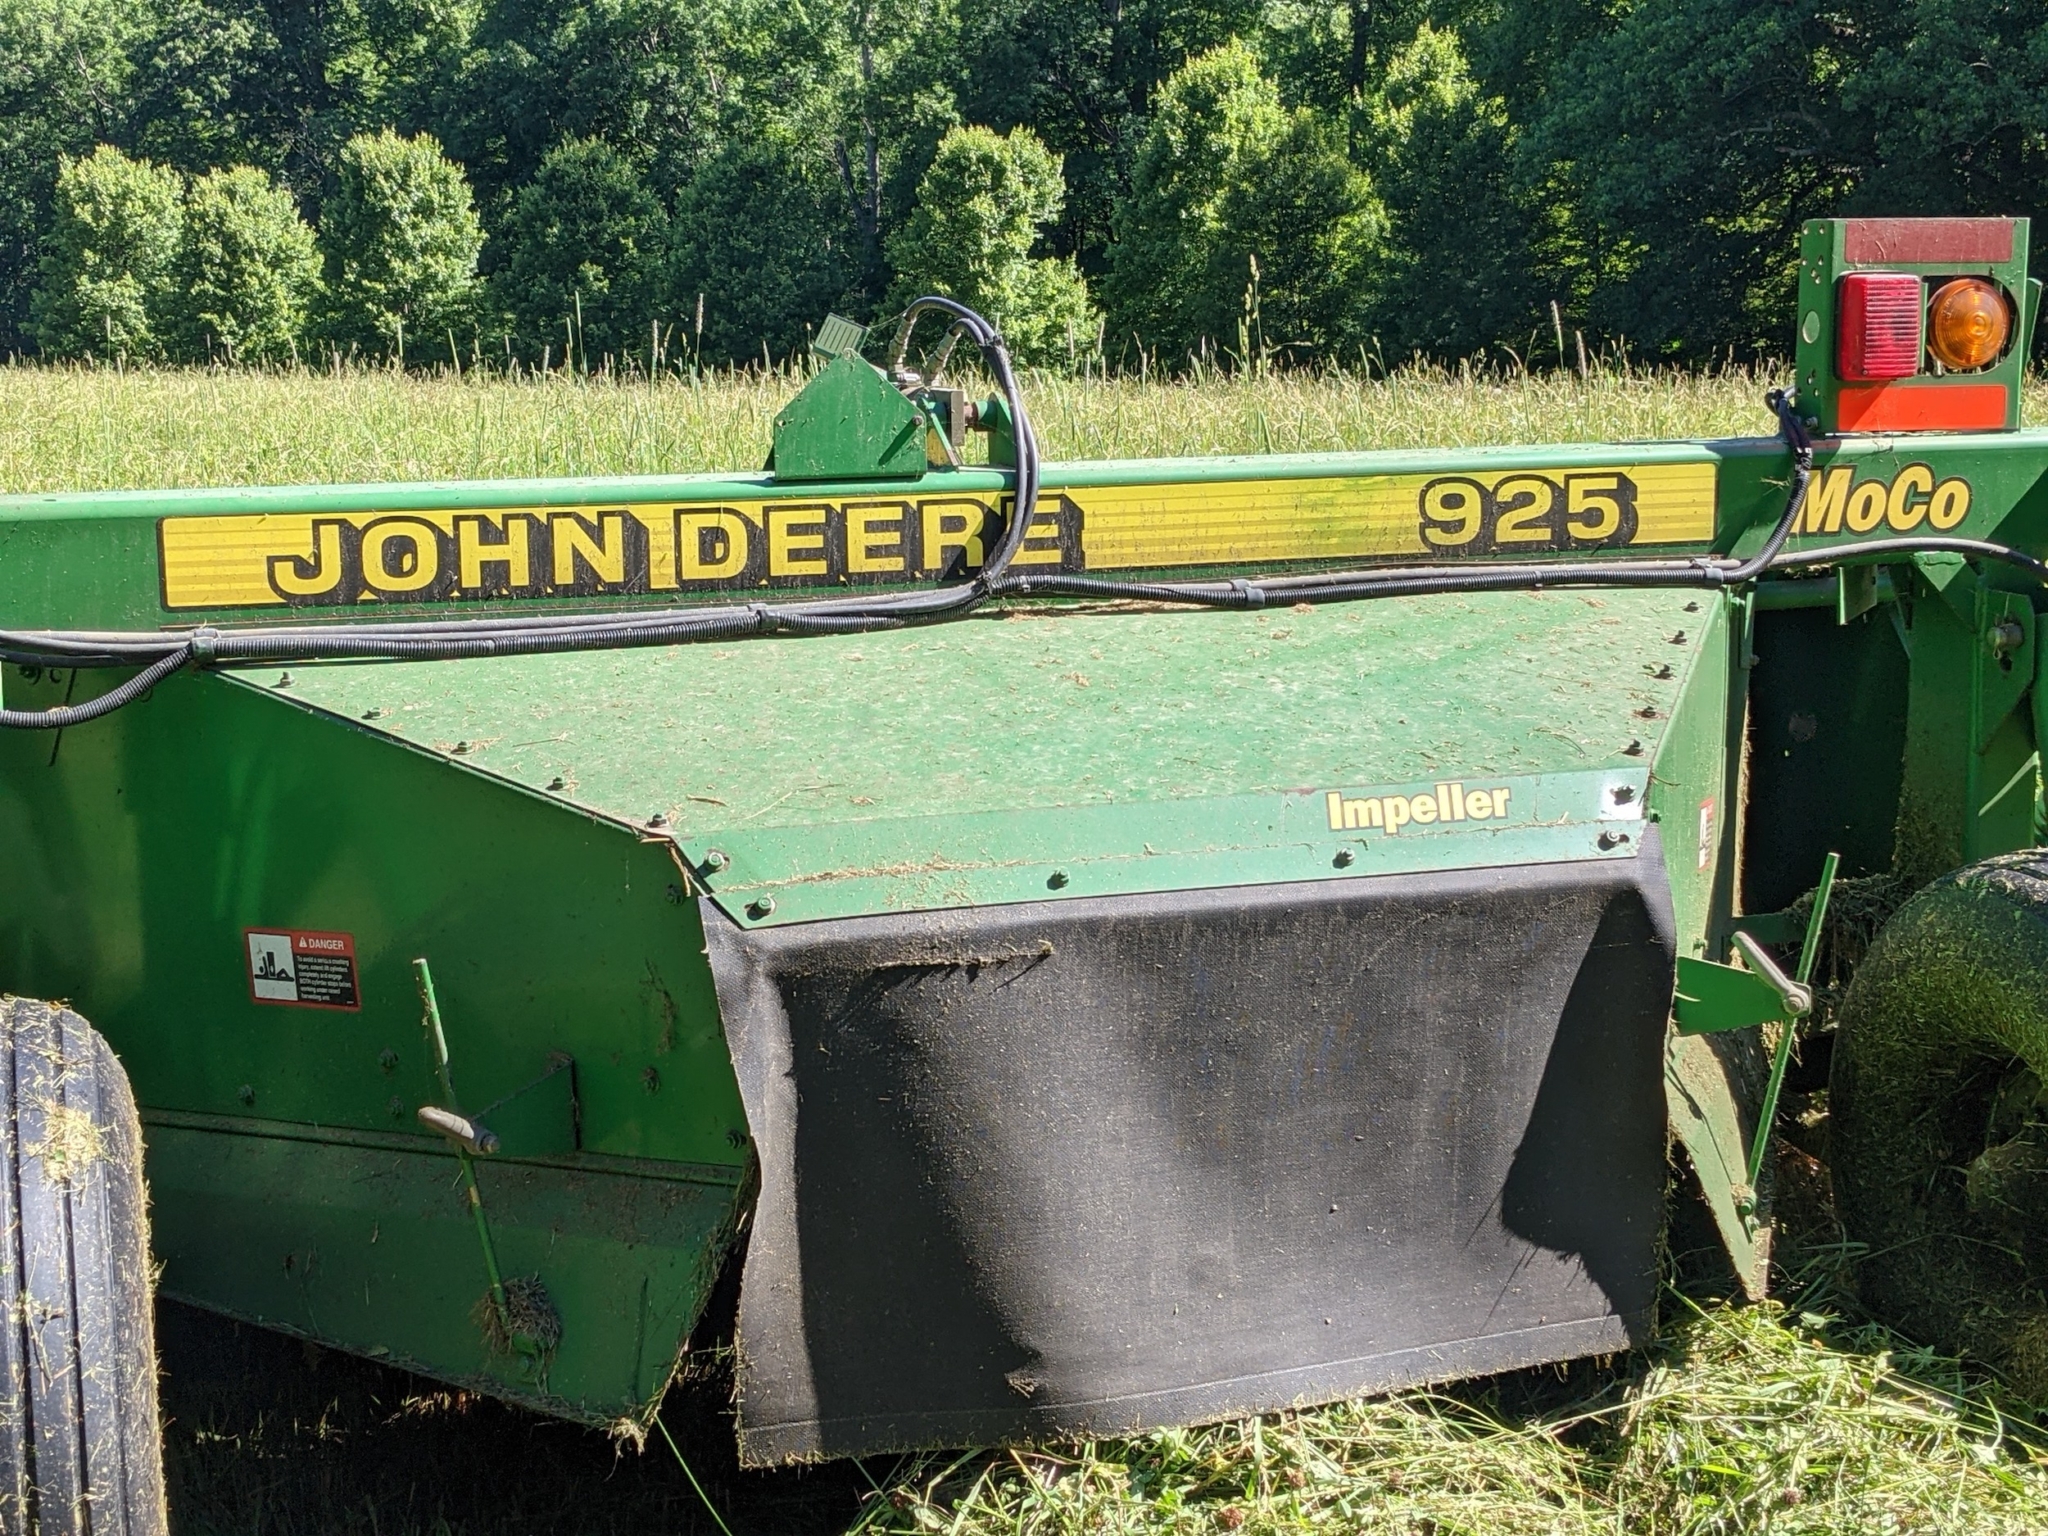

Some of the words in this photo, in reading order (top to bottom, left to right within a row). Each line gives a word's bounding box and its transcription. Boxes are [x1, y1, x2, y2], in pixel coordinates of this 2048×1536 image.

[1788, 465, 1970, 533] MoCo
[270, 513, 628, 597] JOHN
[680, 499, 1063, 581] DEERE
[1424, 475, 1622, 546] 925
[1327, 782, 1512, 835] Impeller
[308, 938, 344, 950] DANGER
